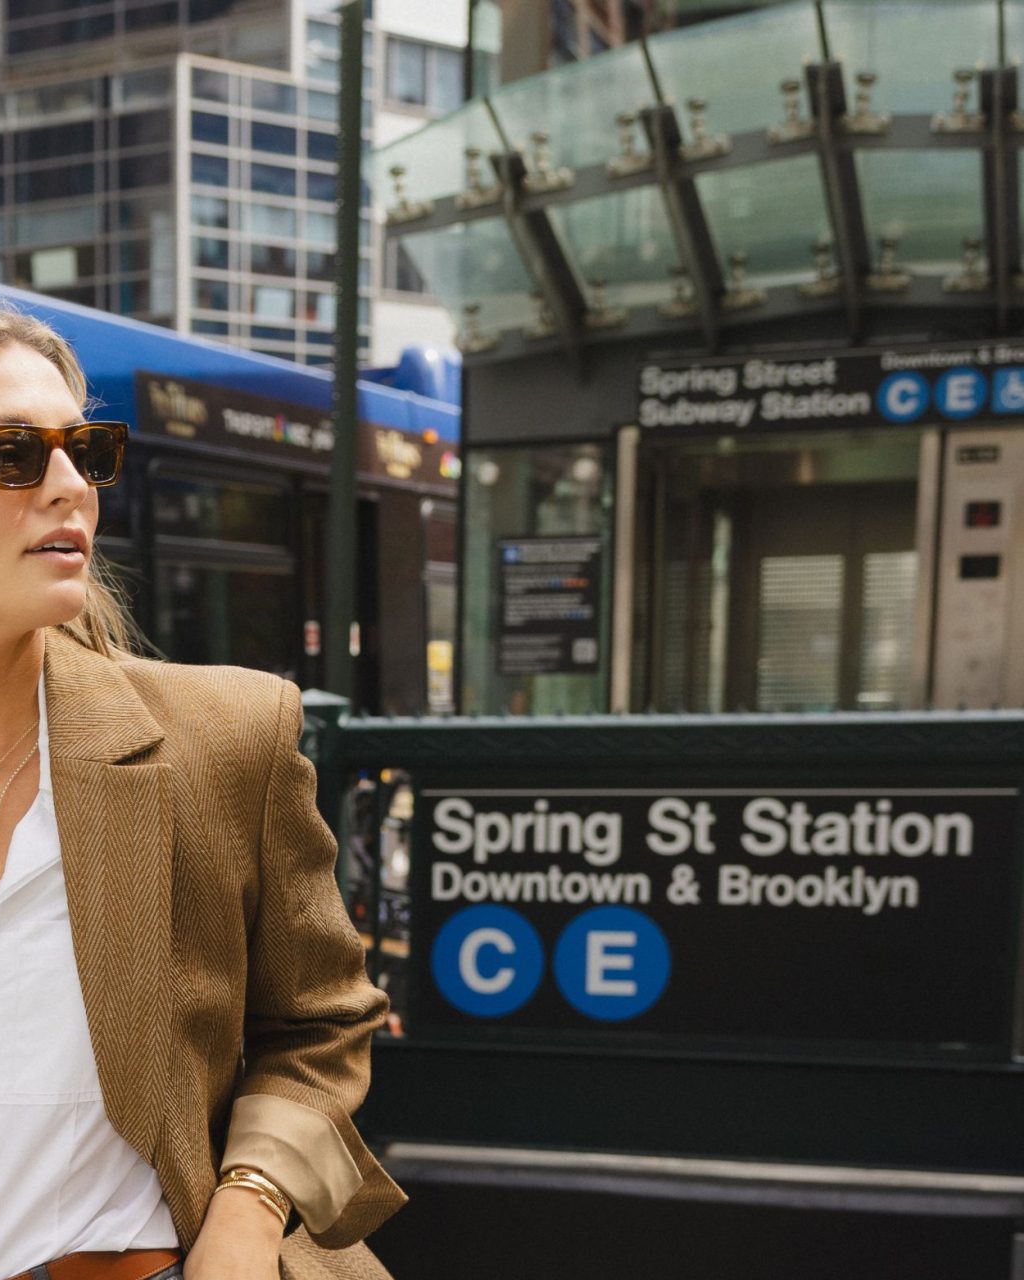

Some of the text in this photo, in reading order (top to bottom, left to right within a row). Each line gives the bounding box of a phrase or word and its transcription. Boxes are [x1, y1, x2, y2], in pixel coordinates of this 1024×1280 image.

[640, 358, 836, 397] Spring Street
[886, 374, 976, 416] C E
[639, 391, 871, 427] Subway Station
[432, 797, 973, 865] Spring St Station
[431, 862, 919, 915] Downtown & Brooklyn
[458, 927, 637, 996] C E
